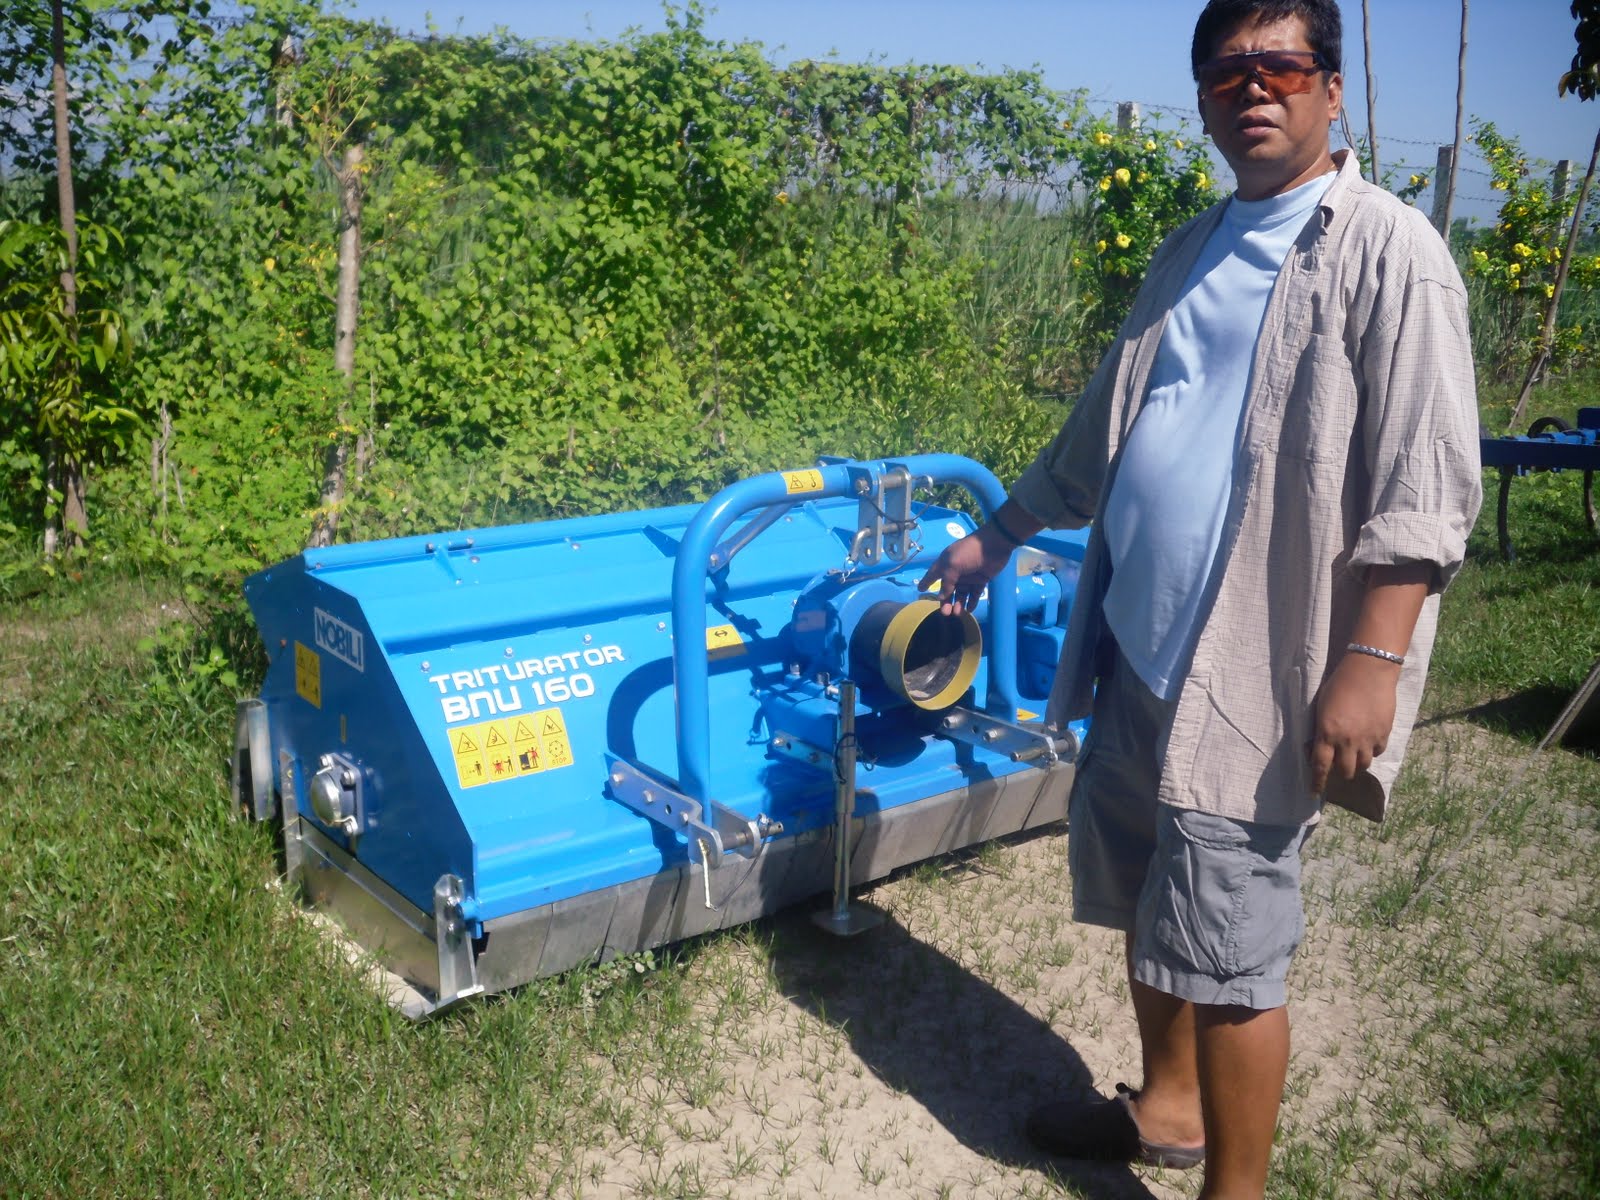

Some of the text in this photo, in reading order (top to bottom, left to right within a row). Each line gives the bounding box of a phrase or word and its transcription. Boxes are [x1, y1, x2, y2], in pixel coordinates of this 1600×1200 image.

[315, 611, 362, 667] NOBILI
[429, 645, 625, 694] TRITURATOR
[441, 673, 595, 723] BNU 160
[551, 756, 567, 766] STOP
